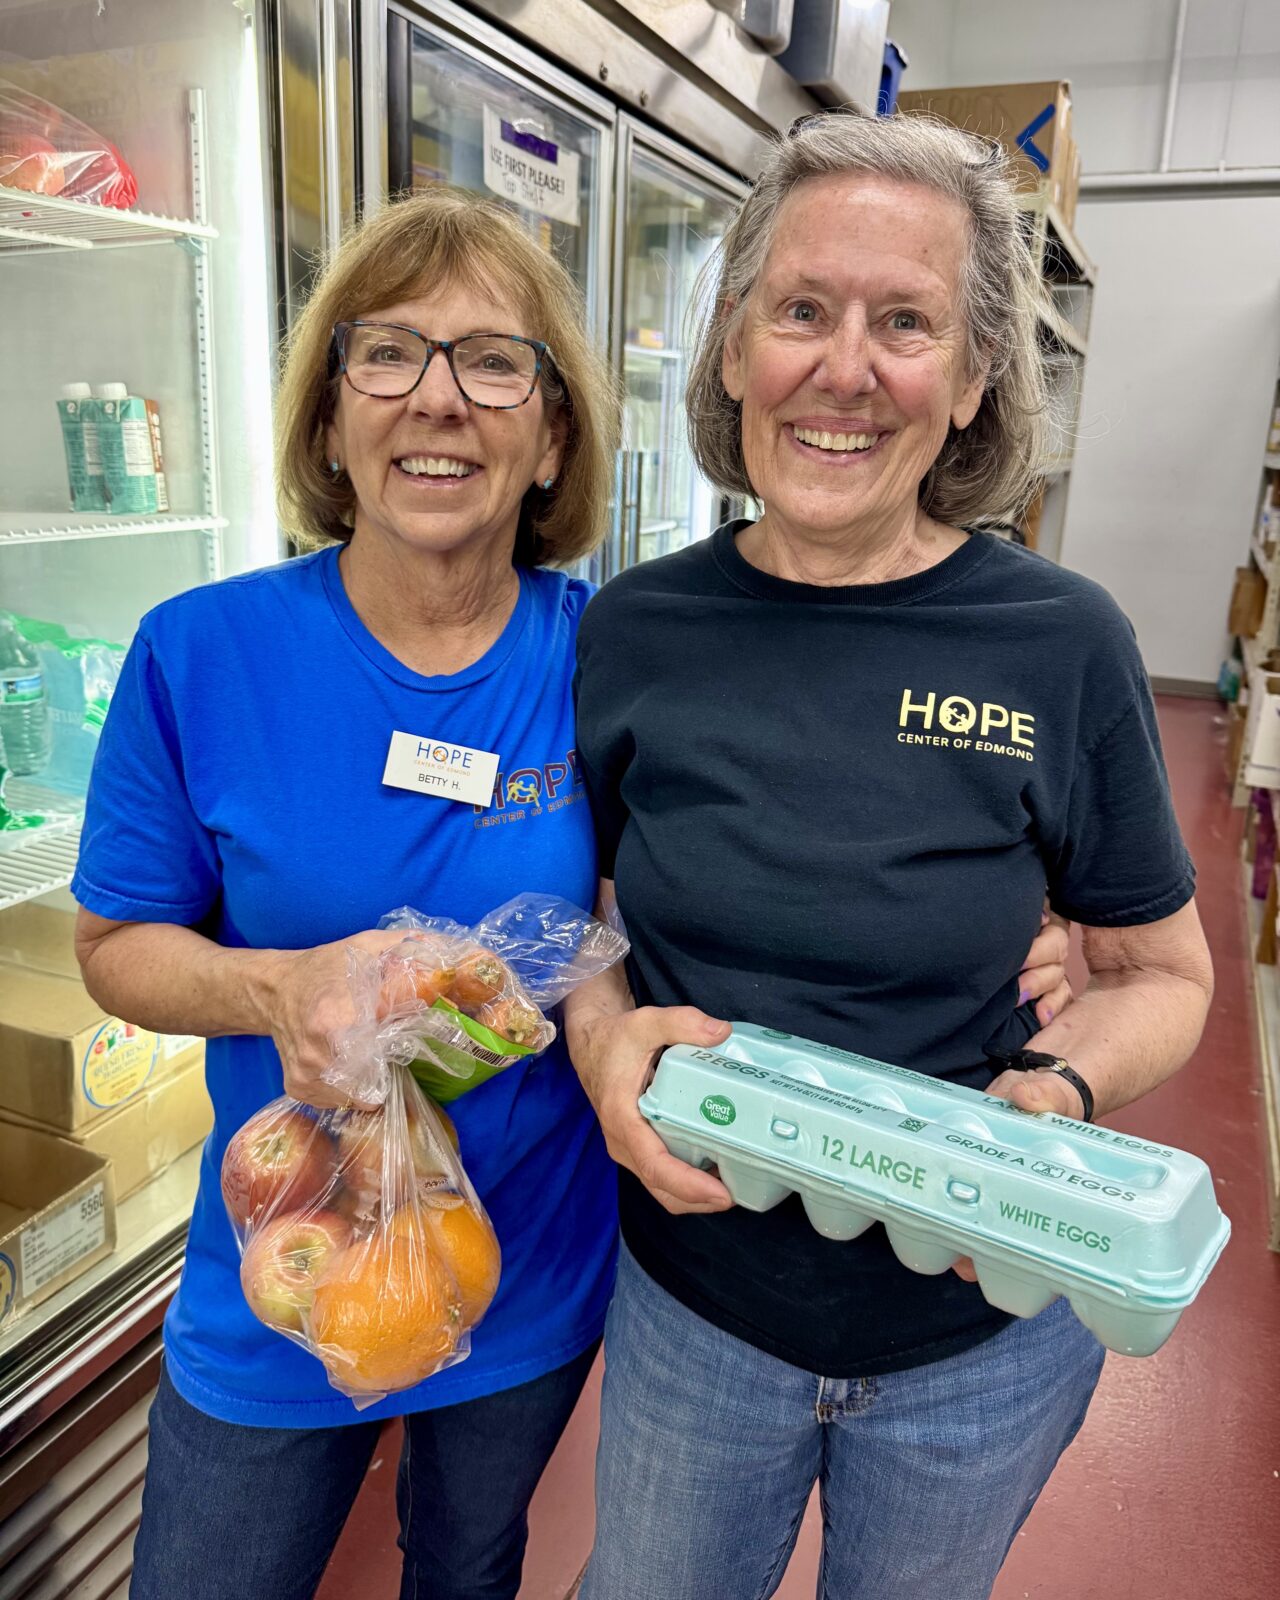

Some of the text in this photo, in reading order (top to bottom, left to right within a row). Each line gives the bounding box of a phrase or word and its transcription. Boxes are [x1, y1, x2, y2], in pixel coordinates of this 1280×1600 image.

[490, 145, 503, 168] USE
[505, 154, 527, 180] FIRST
[899, 688, 1035, 748] HOPE
[416, 741, 474, 769] HOPE
[897, 732, 1034, 762] CENTER OF EDMOND
[414, 759, 435, 768] CENTER
[447, 767, 471, 777] EDMOND
[418, 773, 461, 790] BETTY H.
[474, 810, 526, 830] CENTER
[531, 807, 543, 816] OF
[690, 1050, 770, 1079] 12 EGGS
[909, 1072, 945, 1086] Protein
[705, 1098, 731, 1116] Great
[710, 1109, 729, 1122] Value
[983, 1097, 1174, 1158] LARGE WHITE EGGS
[821, 1135, 926, 1190] 12 LARGE
[945, 1134, 1010, 1159] GRADE
[1010, 1156, 1025, 1166] A
[1067, 1174, 1137, 1201] EGGS
[81, 1190, 104, 1220] 5560
[1000, 1201, 1112, 1253] WHITE EGGS
